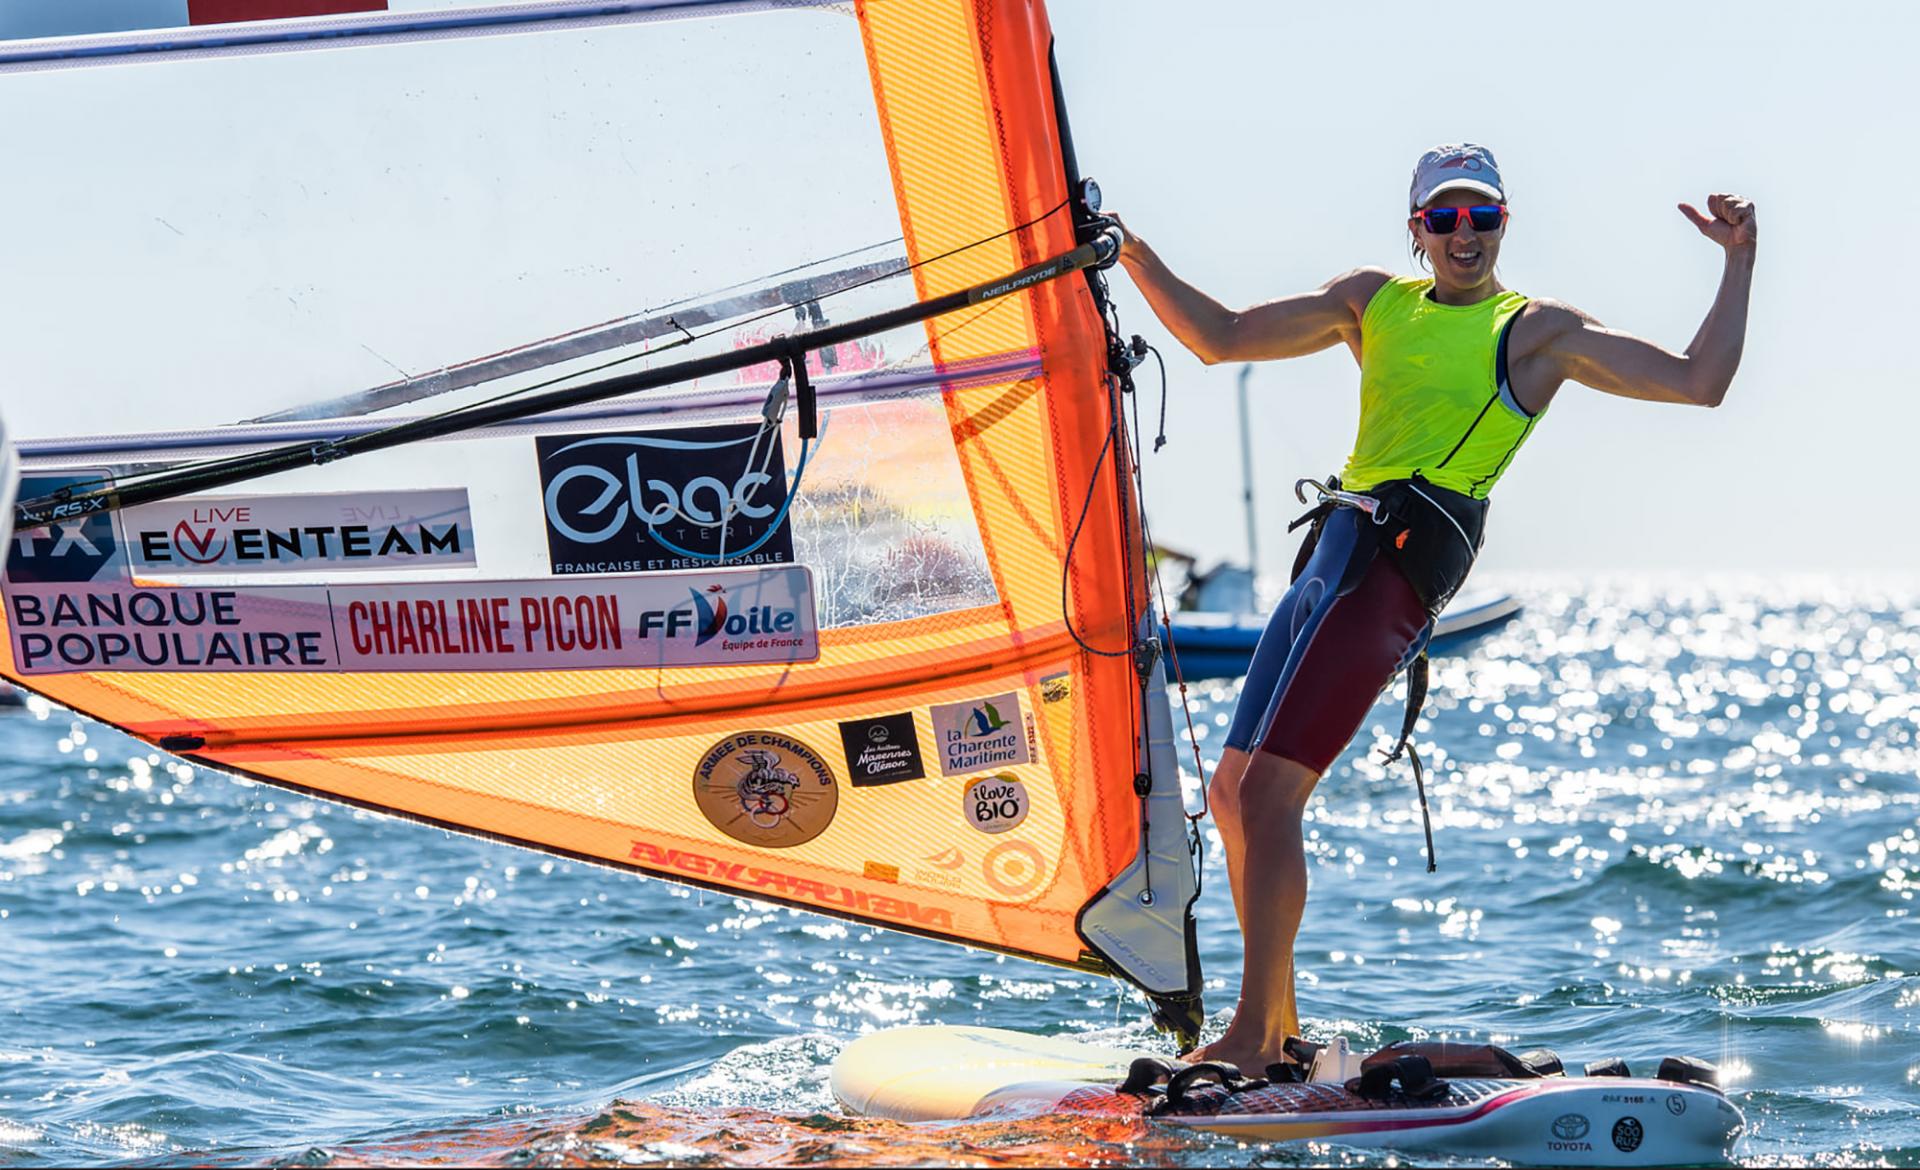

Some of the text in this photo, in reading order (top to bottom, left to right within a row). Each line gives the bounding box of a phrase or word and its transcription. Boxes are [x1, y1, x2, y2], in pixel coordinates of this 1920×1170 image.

[983, 266, 1057, 298] NEILPRYDE
[53, 496, 104, 519] RS:X
[545, 452, 776, 543] ebac
[193, 507, 250, 523] LIVE
[140, 520, 461, 564] EVENTEAM
[636, 523, 778, 543] LTERI
[556, 560, 641, 574] FRANÇAISE
[648, 559, 664, 570] ET
[11, 591, 241, 626] BANQUE
[349, 594, 622, 655] CHARLINE PICON
[20, 632, 326, 668] POPULAIRE
[722, 638, 803, 651] Équipe de France
[947, 729, 962, 742] la
[948, 735, 1016, 756] Charente
[736, 734, 757, 748] DE
[760, 735, 832, 786] CHAMPIONS
[949, 749, 1016, 770] Maritime
[980, 785, 1015, 800] love
[976, 800, 1019, 822] BIO
[1547, 1141, 1592, 1152] TOYOTA
